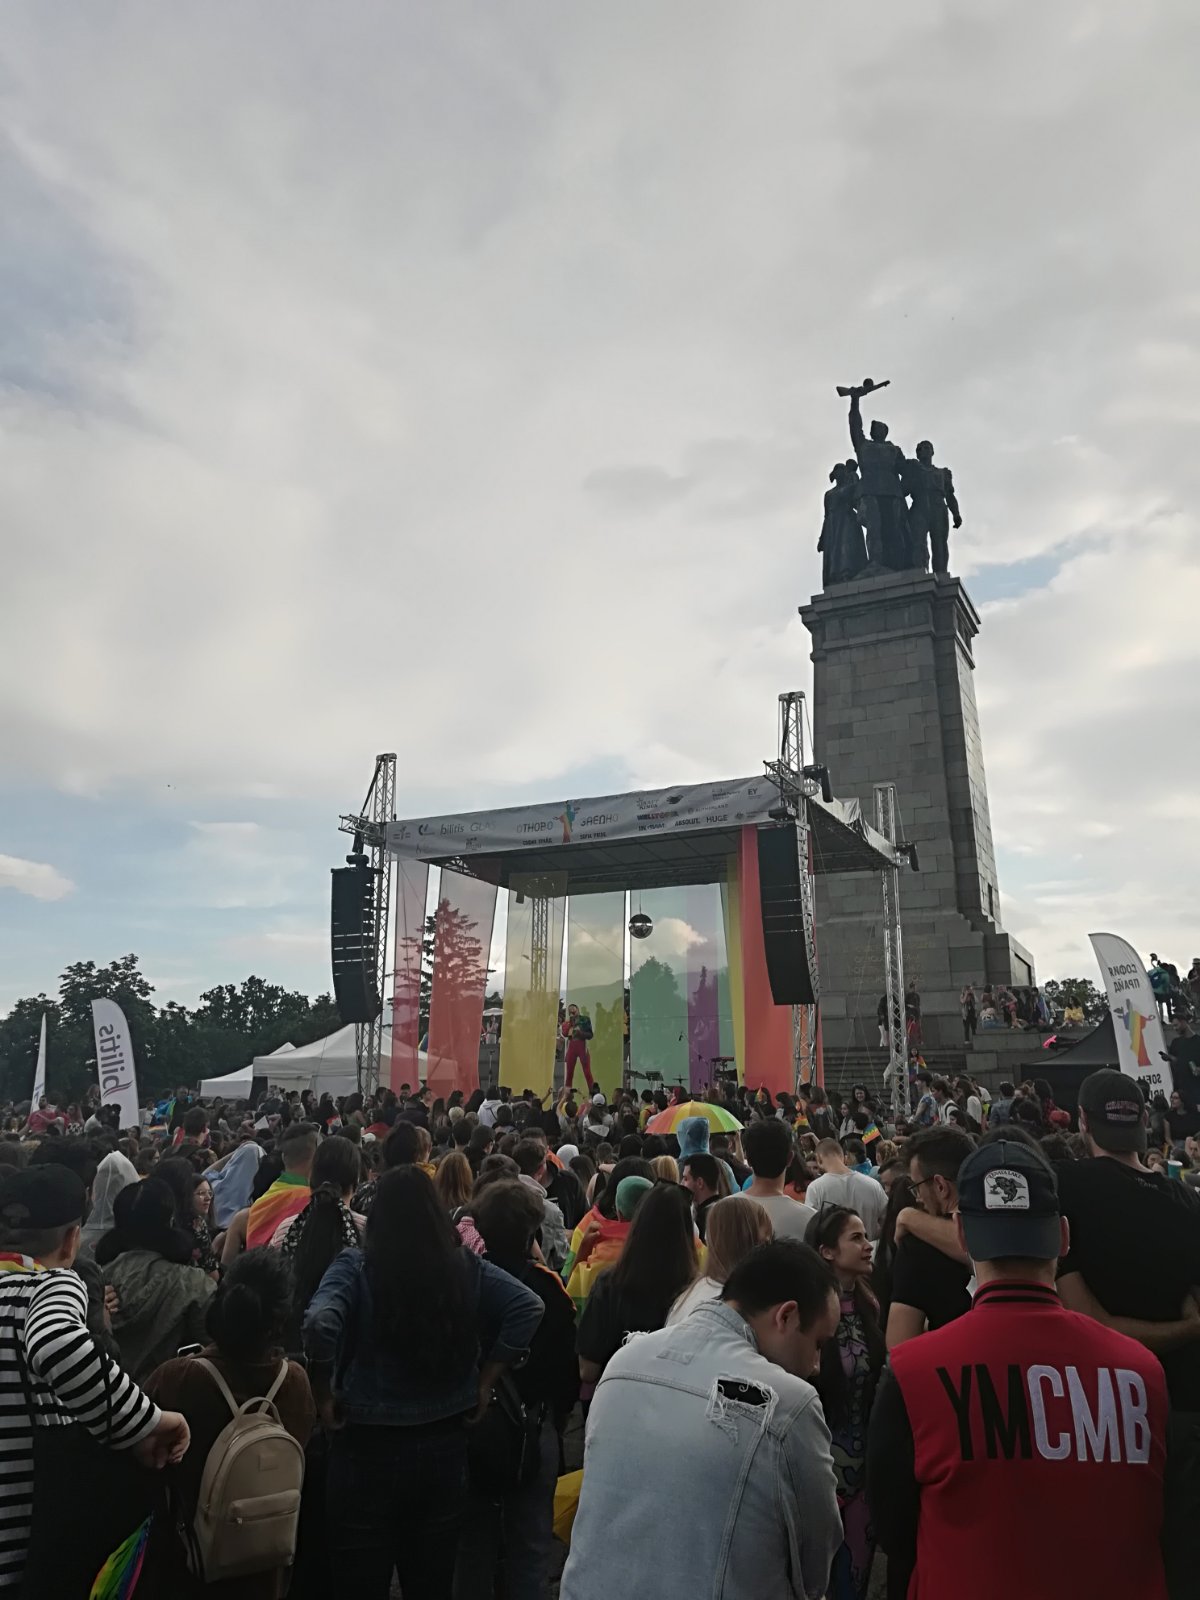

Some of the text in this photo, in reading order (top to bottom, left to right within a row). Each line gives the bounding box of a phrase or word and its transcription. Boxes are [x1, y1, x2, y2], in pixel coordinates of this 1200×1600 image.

[747, 788, 758, 796] EY
[706, 814, 729, 823] HUGE
[935, 1363, 1152, 1465] YMCMB
